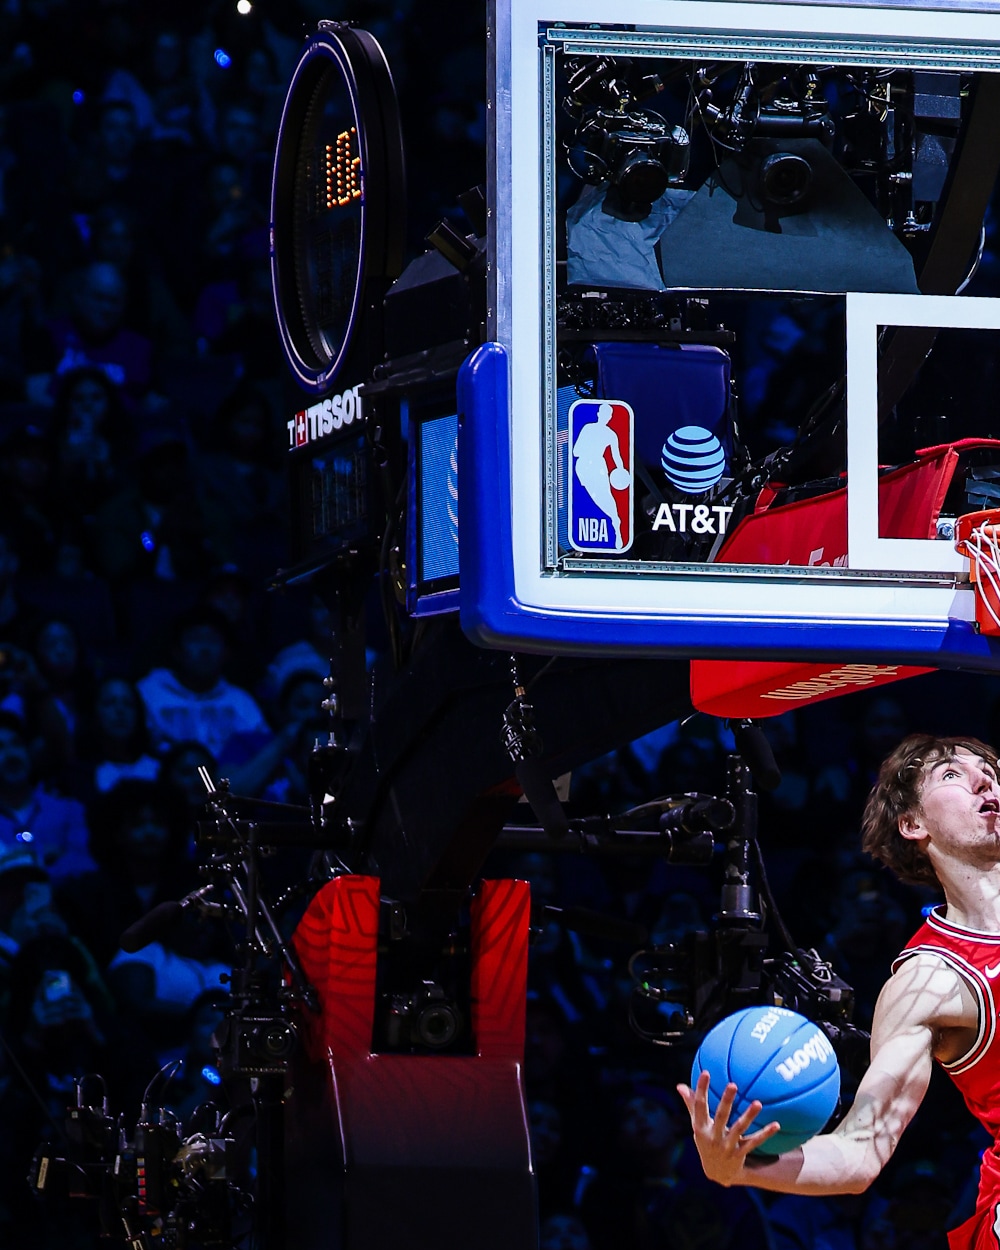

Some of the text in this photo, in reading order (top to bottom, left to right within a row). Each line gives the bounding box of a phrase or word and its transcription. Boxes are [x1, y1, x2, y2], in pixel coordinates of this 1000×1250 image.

[307, 382, 364, 440] TISSOT
[578, 517, 609, 543] NBA
[651, 502, 734, 535] AT&T
